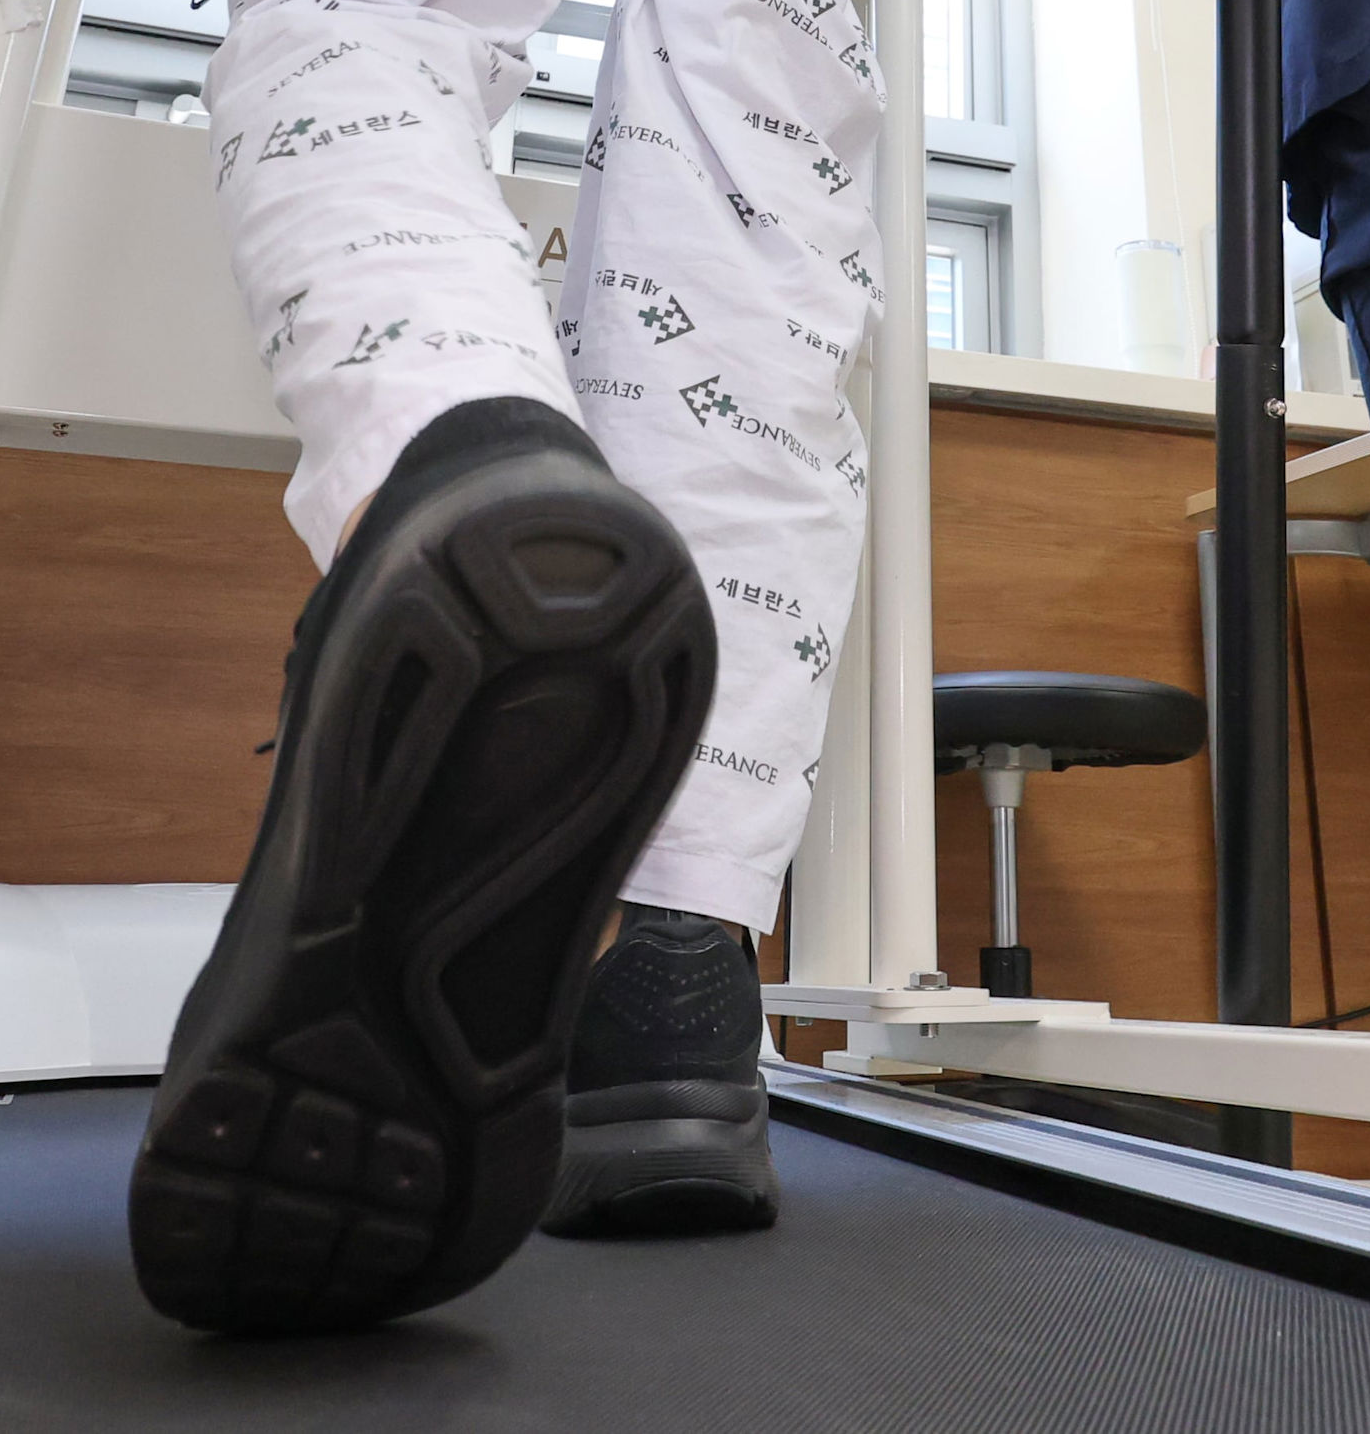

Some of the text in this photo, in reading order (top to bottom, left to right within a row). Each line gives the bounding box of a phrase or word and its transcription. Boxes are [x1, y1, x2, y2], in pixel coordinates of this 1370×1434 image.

[310, 110, 422, 152] 세브란스
[742, 110, 820, 146] 세브란스
[731, 413, 822, 472] SEVERANCE
[715, 576, 803, 619] 세브란스
[694, 743, 780, 786] ERANCE
